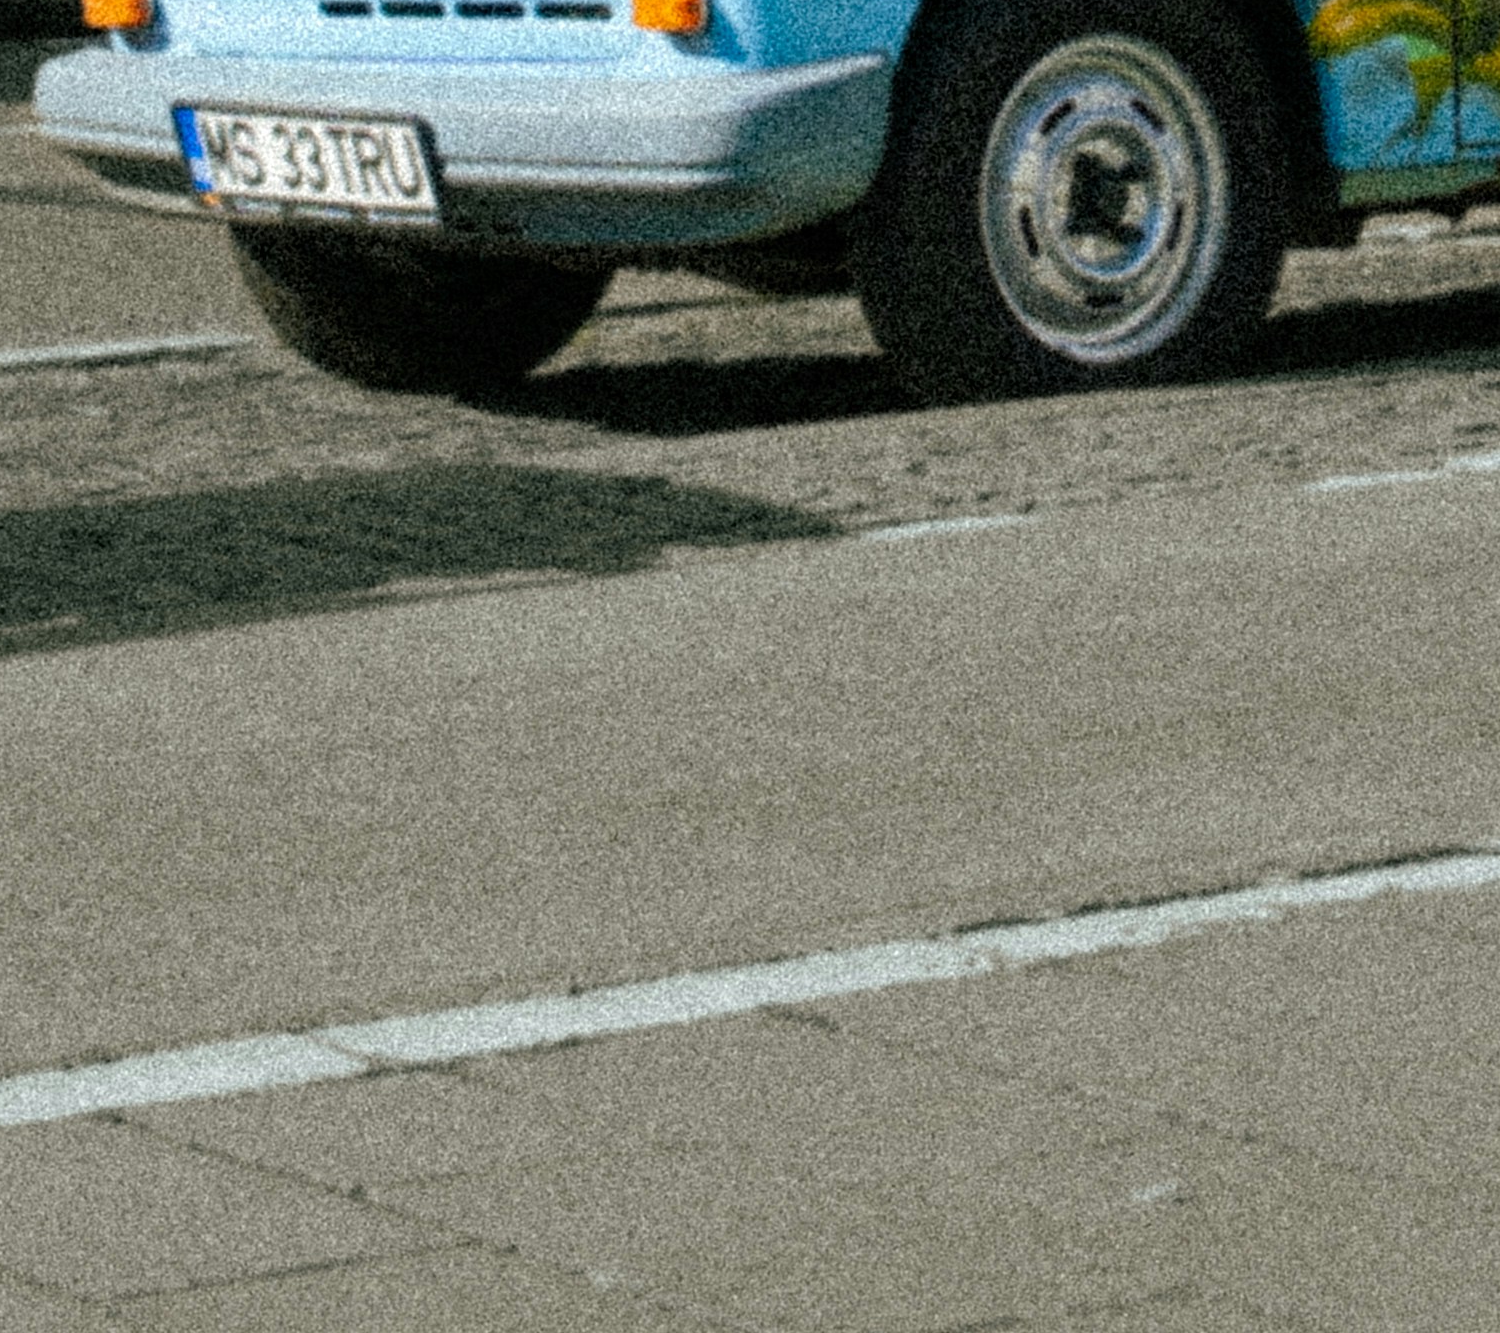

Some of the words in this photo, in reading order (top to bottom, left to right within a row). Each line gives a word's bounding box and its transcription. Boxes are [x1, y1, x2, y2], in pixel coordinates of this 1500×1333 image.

[203, 118, 266, 187] MS
[272, 123, 329, 190] 33
[326, 127, 423, 198] TRU
